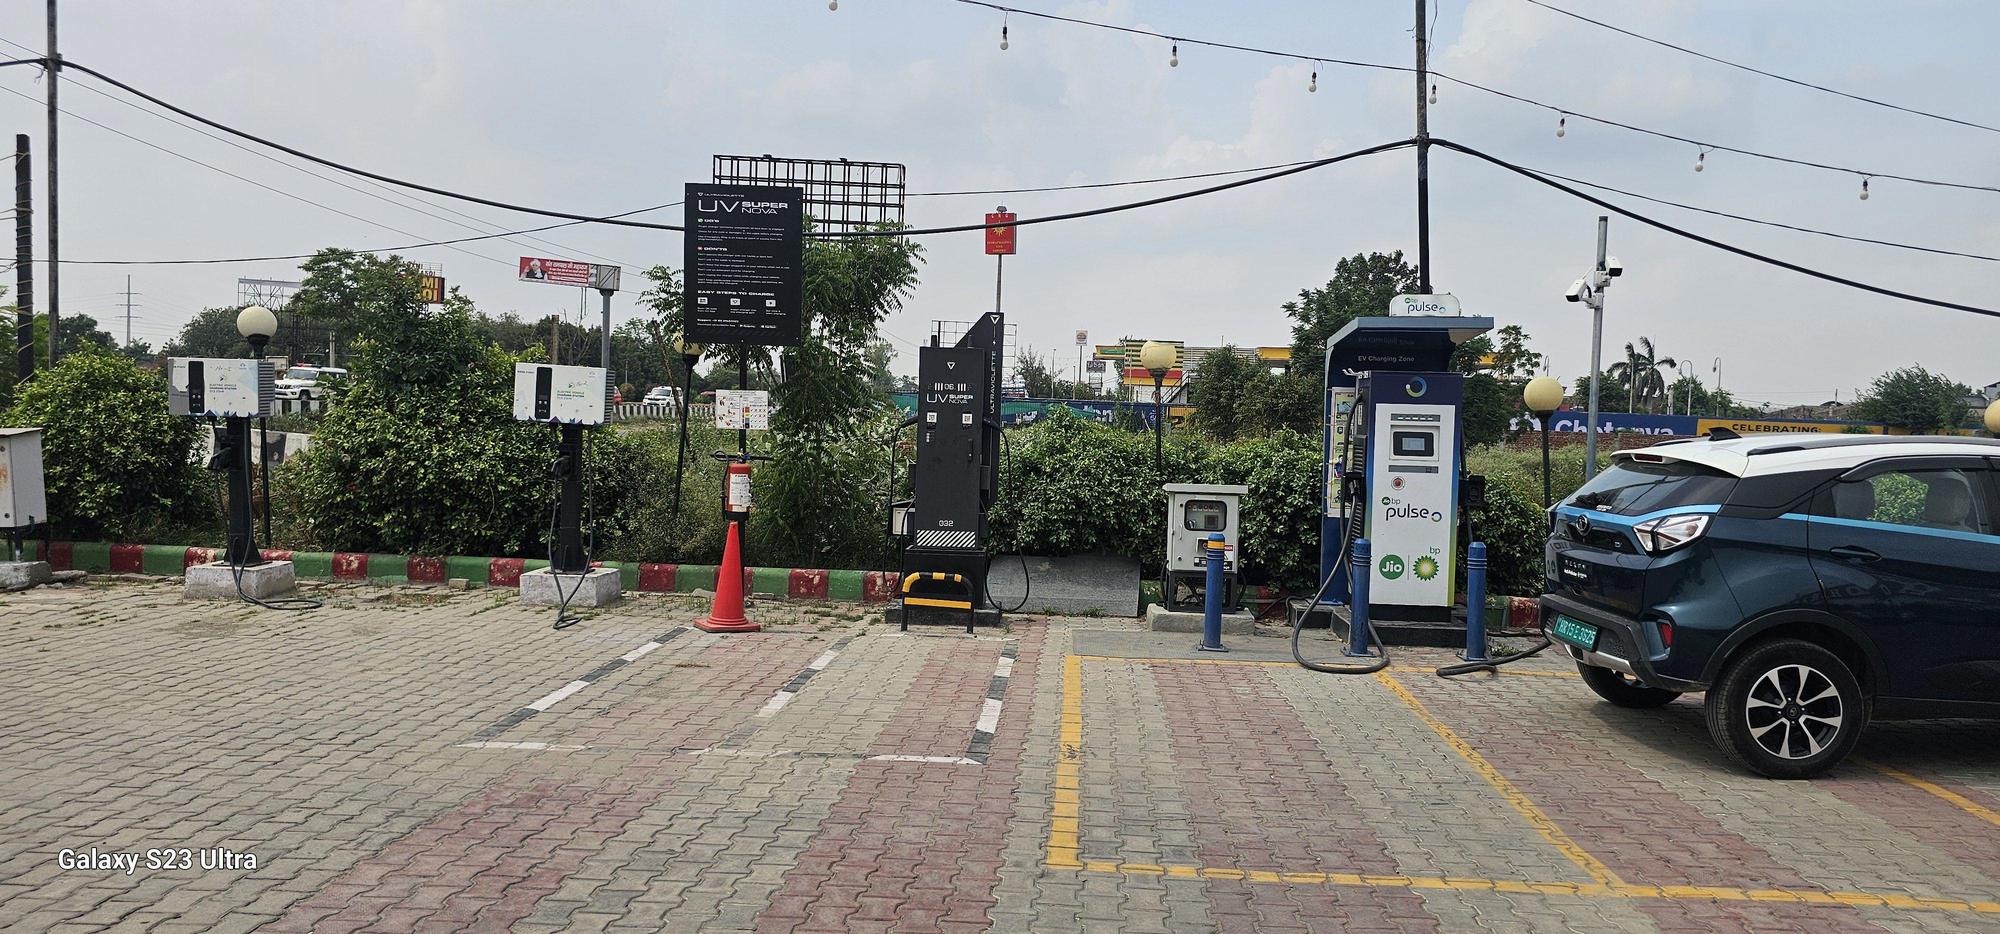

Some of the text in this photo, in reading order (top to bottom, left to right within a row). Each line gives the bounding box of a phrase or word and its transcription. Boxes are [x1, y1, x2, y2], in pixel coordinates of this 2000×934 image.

[698, 199, 788, 213] UV SUPER
[1407, 301, 1438, 314] pulse
[1368, 355, 1397, 363] Charging
[989, 350, 997, 414] ULTRAVIOLETTE
[926, 393, 949, 403] UV
[1386, 503, 1430, 521] pulse
[1429, 546, 1441, 555] bp
[1381, 560, 1403, 572] Jio
